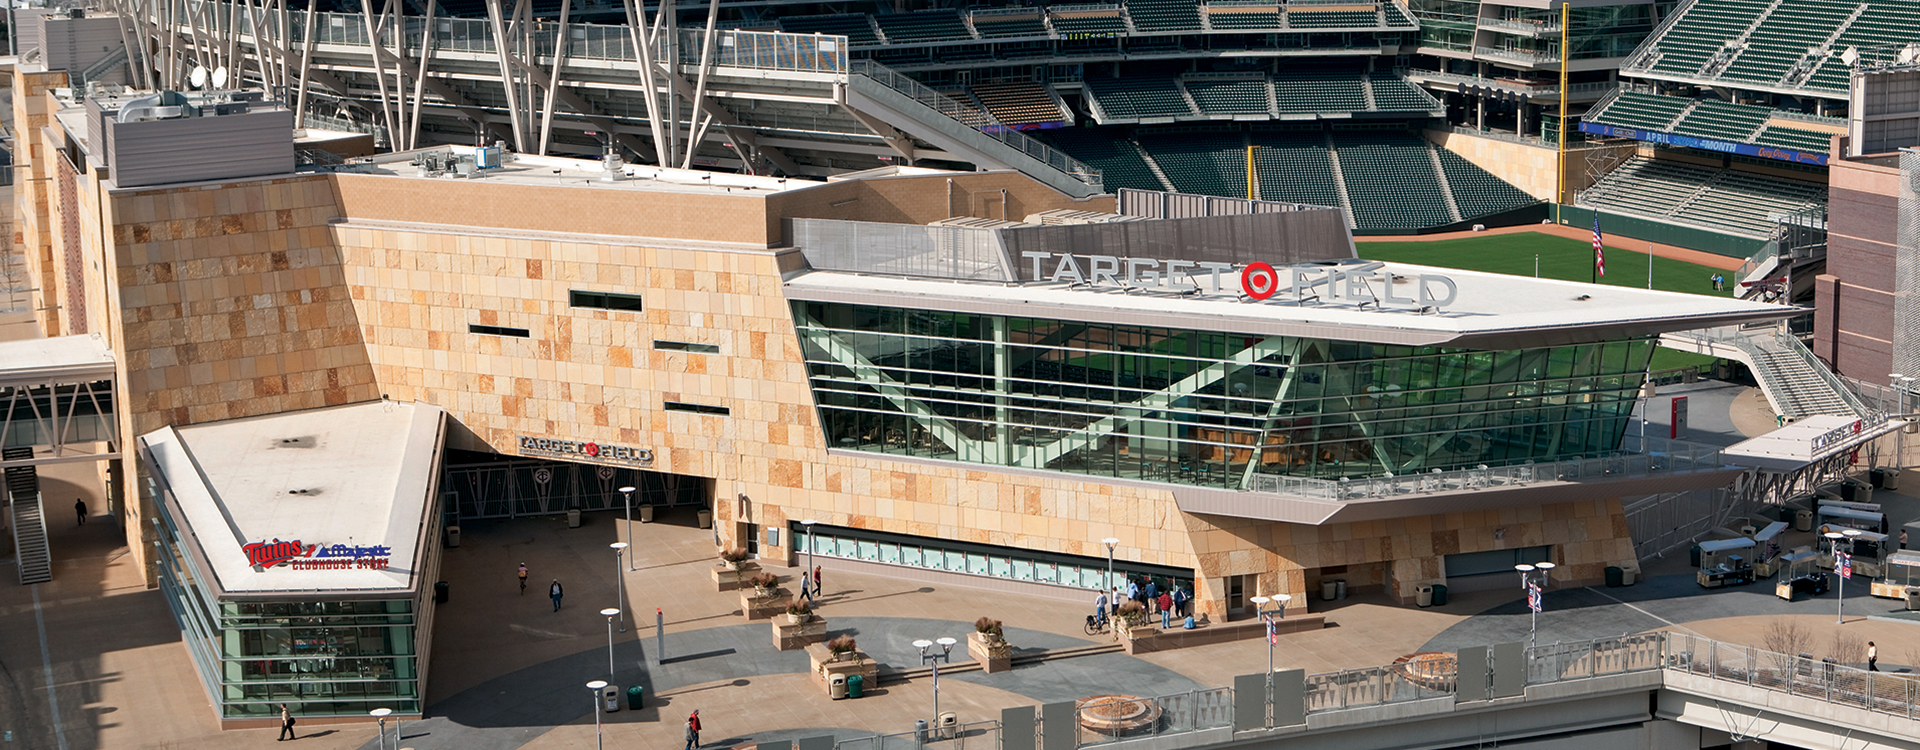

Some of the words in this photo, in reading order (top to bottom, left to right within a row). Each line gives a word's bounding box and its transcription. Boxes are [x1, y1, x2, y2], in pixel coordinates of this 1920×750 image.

[1645, 132, 1670, 144] APRIL
[1705, 141, 1737, 152] MONTH
[1021, 250, 1233, 293] TARGET
[1292, 267, 1458, 308] FIELD
[516, 435, 582, 453] TARGET
[600, 444, 652, 461] FIELD
[242, 538, 302, 568] Twins
[331, 544, 391, 561] Majestic
[292, 558, 353, 571] CLUBHOUSE
[357, 558, 389, 570] STORE
